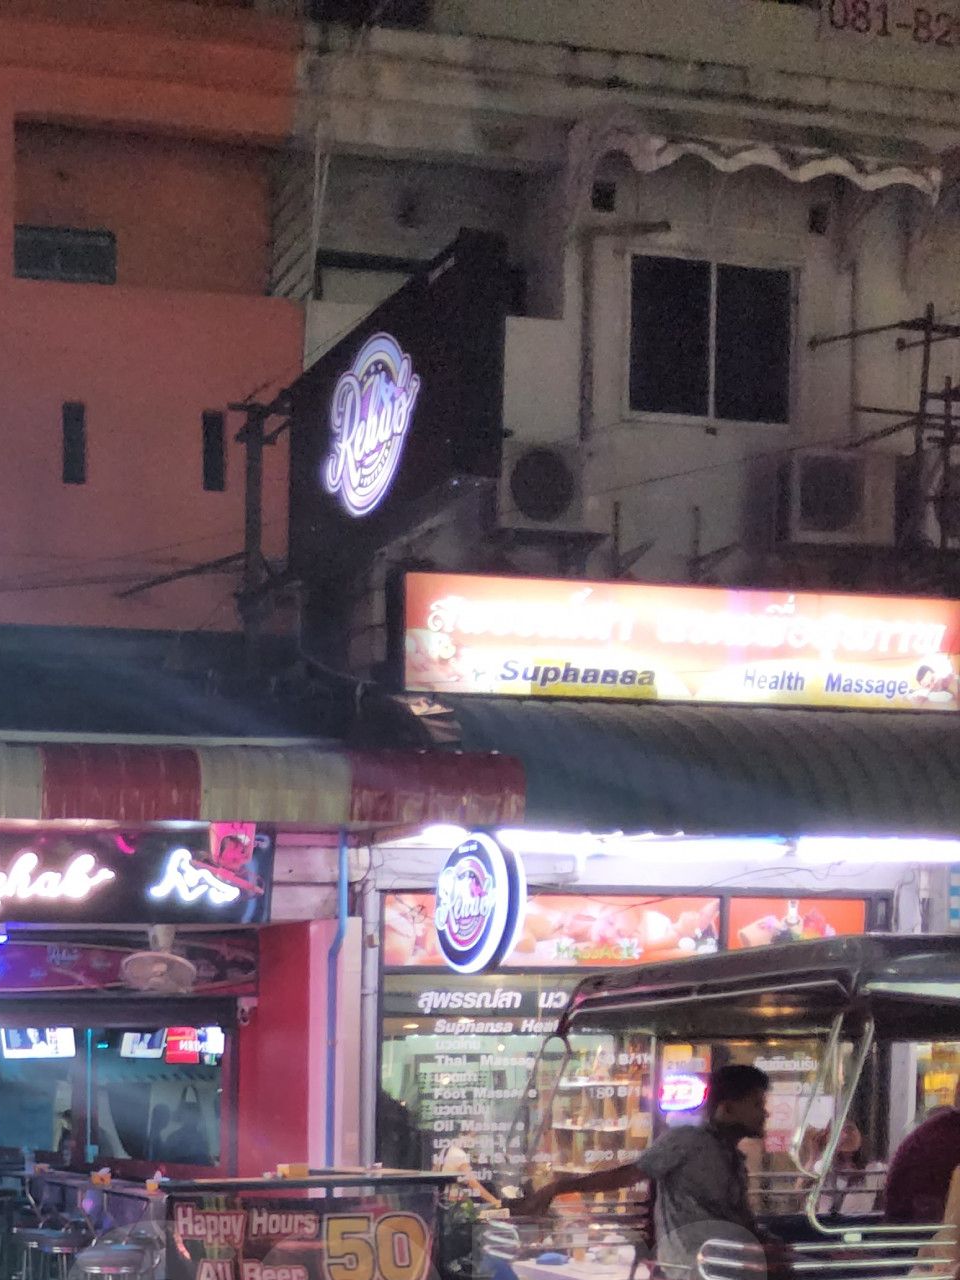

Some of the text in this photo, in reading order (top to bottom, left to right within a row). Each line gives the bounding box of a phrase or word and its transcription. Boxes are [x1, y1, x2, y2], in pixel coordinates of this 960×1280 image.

[743, 668, 908, 698] Health Massage
[473, 1088, 538, 1100] Massae
[461, 1120, 525, 1132] Massae
[175, 1203, 320, 1248] Happy Hours
